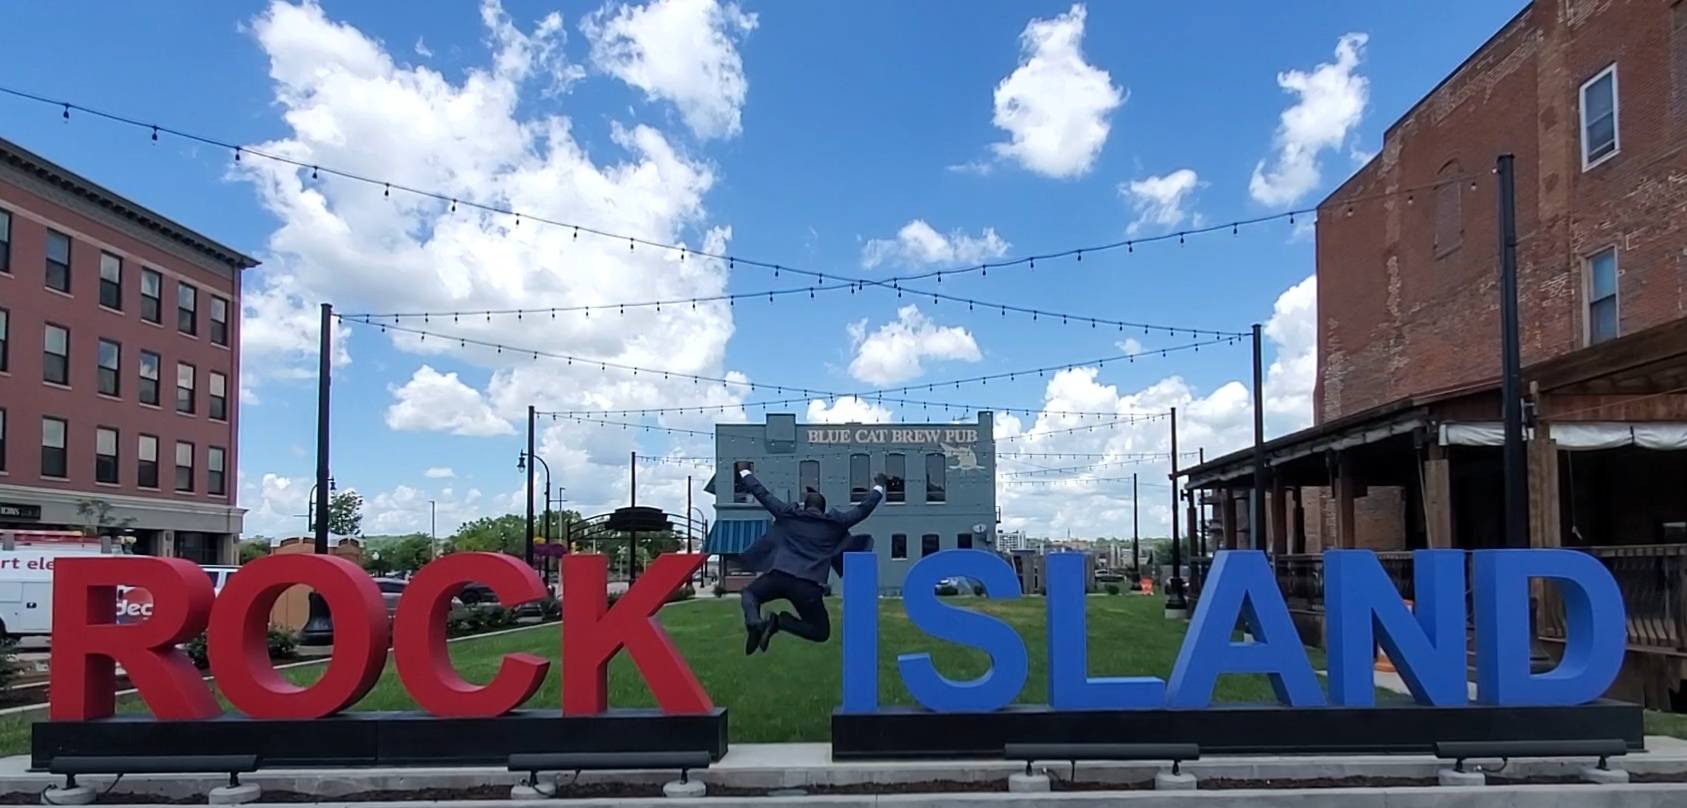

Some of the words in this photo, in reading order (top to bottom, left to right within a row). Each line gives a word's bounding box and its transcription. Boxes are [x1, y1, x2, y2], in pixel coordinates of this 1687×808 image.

[807, 429, 850, 444] BLUE
[855, 429, 887, 444] CAT
[892, 429, 940, 443] BREW
[944, 429, 978, 443] PUB
[49, 551, 715, 721] ROCK
[841, 548, 1627, 713] ISLAND
